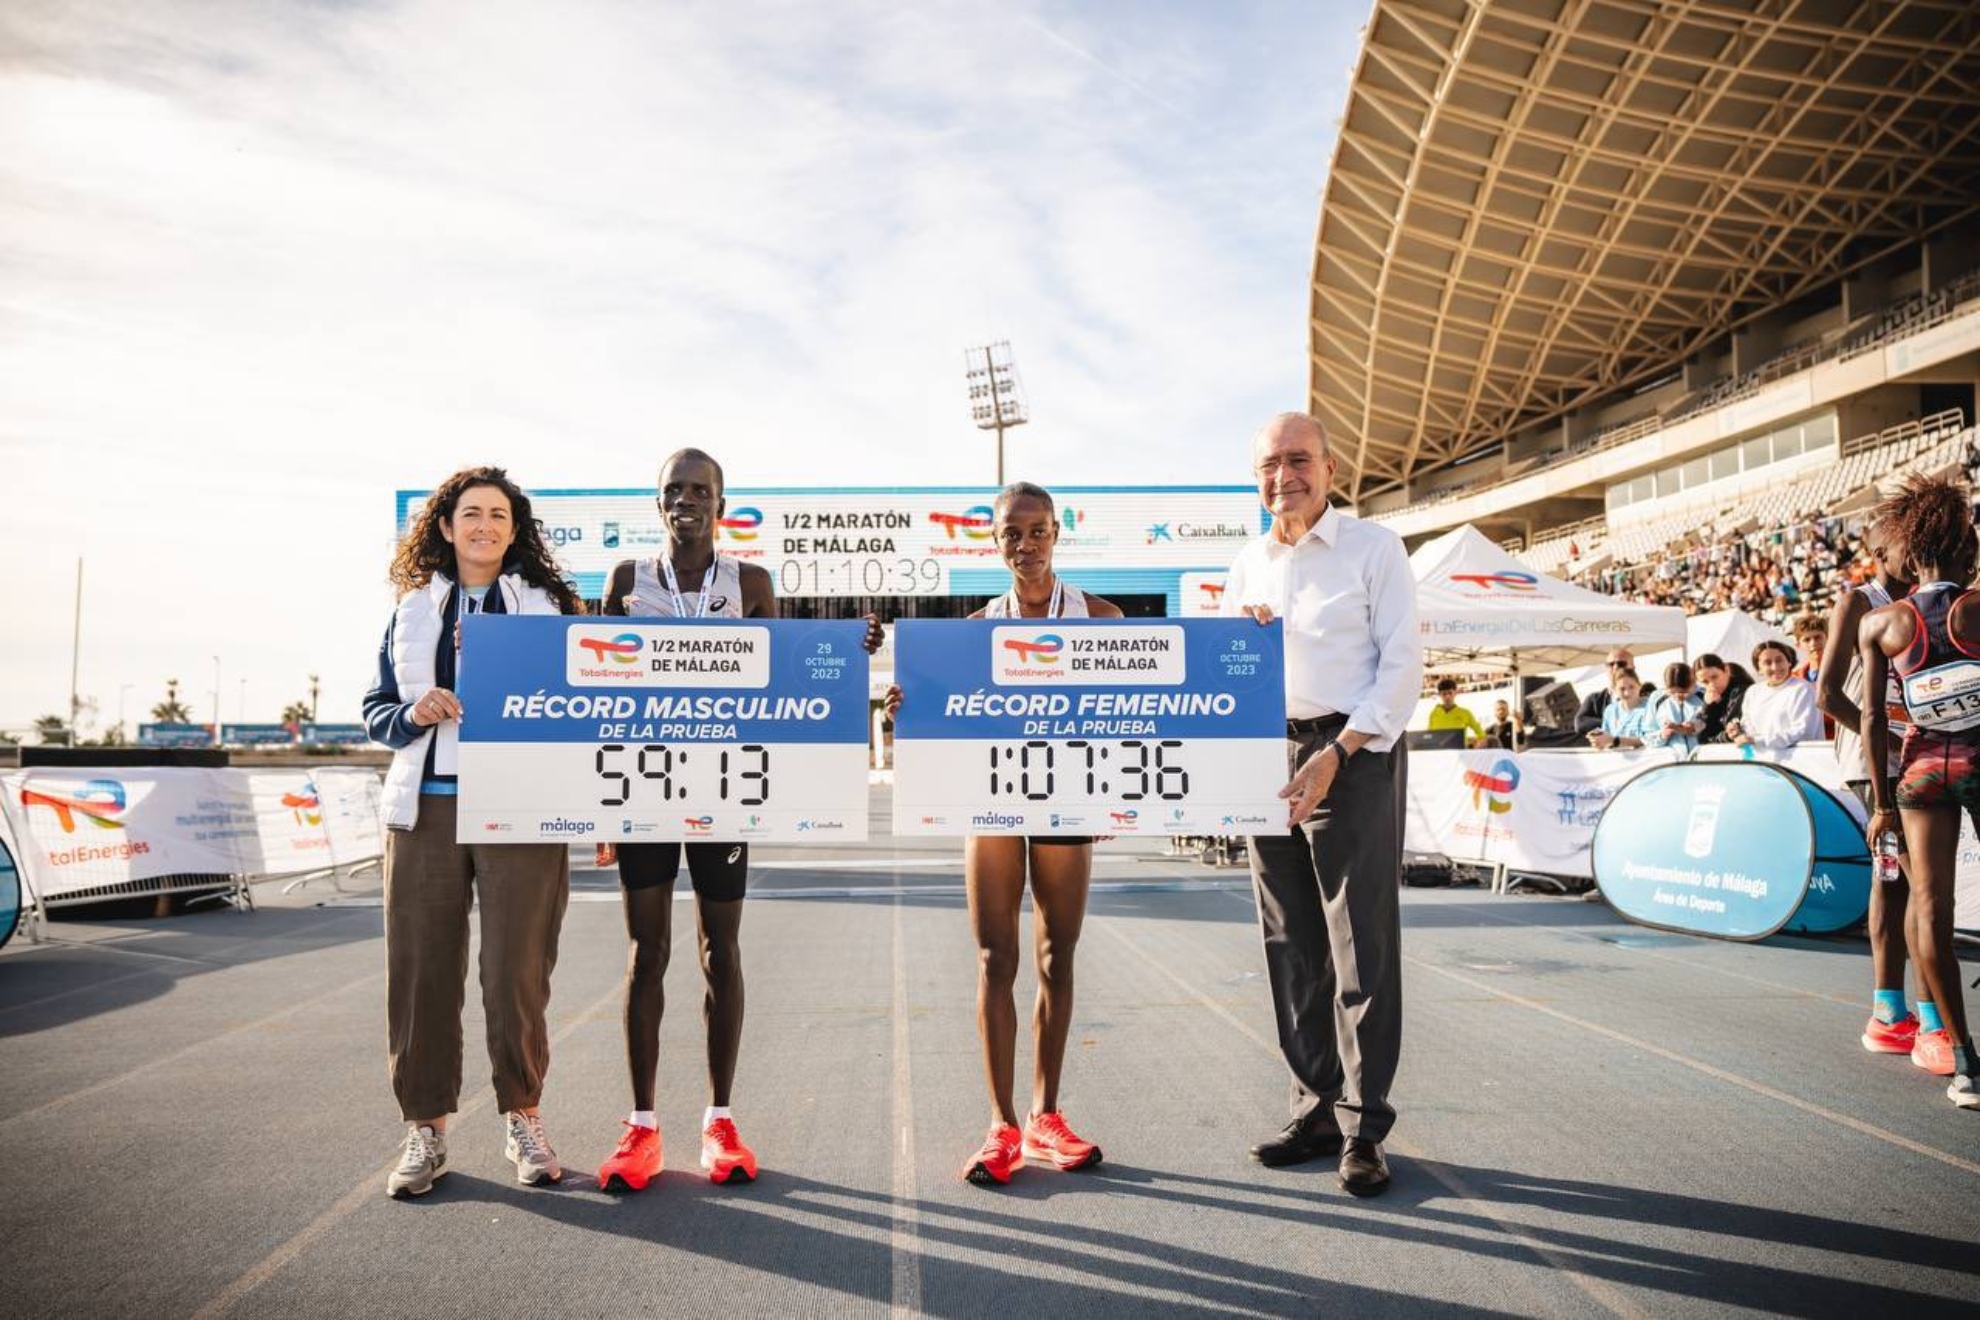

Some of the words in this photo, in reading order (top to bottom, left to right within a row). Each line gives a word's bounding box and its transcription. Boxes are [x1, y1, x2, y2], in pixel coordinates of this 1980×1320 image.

[784, 514, 811, 529] 1/2
[817, 510, 911, 529] MARATÓN
[1178, 523, 1249, 538] CaixaBank
[784, 538, 808, 553] DE
[814, 535, 895, 553] MÁLAGA
[781, 558, 941, 594] 01:10:39
[651, 639, 675, 653] 1/2
[679, 637, 754, 654] MARATÓN
[816, 643, 832, 655] 29
[1071, 639, 1095, 652] 1/2
[1097, 637, 1169, 652] MARATÓN
[1231, 640, 1246, 651] 29
[651, 659, 672, 672] DE
[676, 656, 740, 673] MÁLAGA
[805, 657, 847, 667] OCTUBRE
[1071, 658, 1091, 671] DE
[1095, 655, 1158, 671] MÁLAGA
[1219, 655, 1261, 663] OCTUBRE
[579, 668, 644, 680] TotalEnergies
[811, 669, 841, 680] 2023
[1004, 668, 1065, 679] TotalEnergies
[1226, 665, 1256, 676] 2023
[502, 689, 636, 719] RÉCORD
[645, 695, 831, 721] MASCULINO
[945, 688, 1069, 717] RÉCORD
[1077, 693, 1236, 717] FEMENINO
[598, 724, 625, 738] DE
[630, 725, 654, 738] LA
[659, 725, 738, 739] PRUEBA
[1023, 721, 1050, 735] DE
[1055, 721, 1075, 735] LA
[1082, 721, 1157, 735] PRUEBA
[596, 745, 769, 806] 59:13
[990, 741, 1189, 801] 1:07:36
[540, 817, 595, 834] málaga
[972, 811, 1024, 828] málaga
[1622, 860, 1702, 886] Ayuntamiento
[1704, 870, 1720, 889] de
[1722, 872, 1768, 898] Málaga
[1676, 893, 1687, 906] de
[1689, 894, 1726, 913] Deporte
